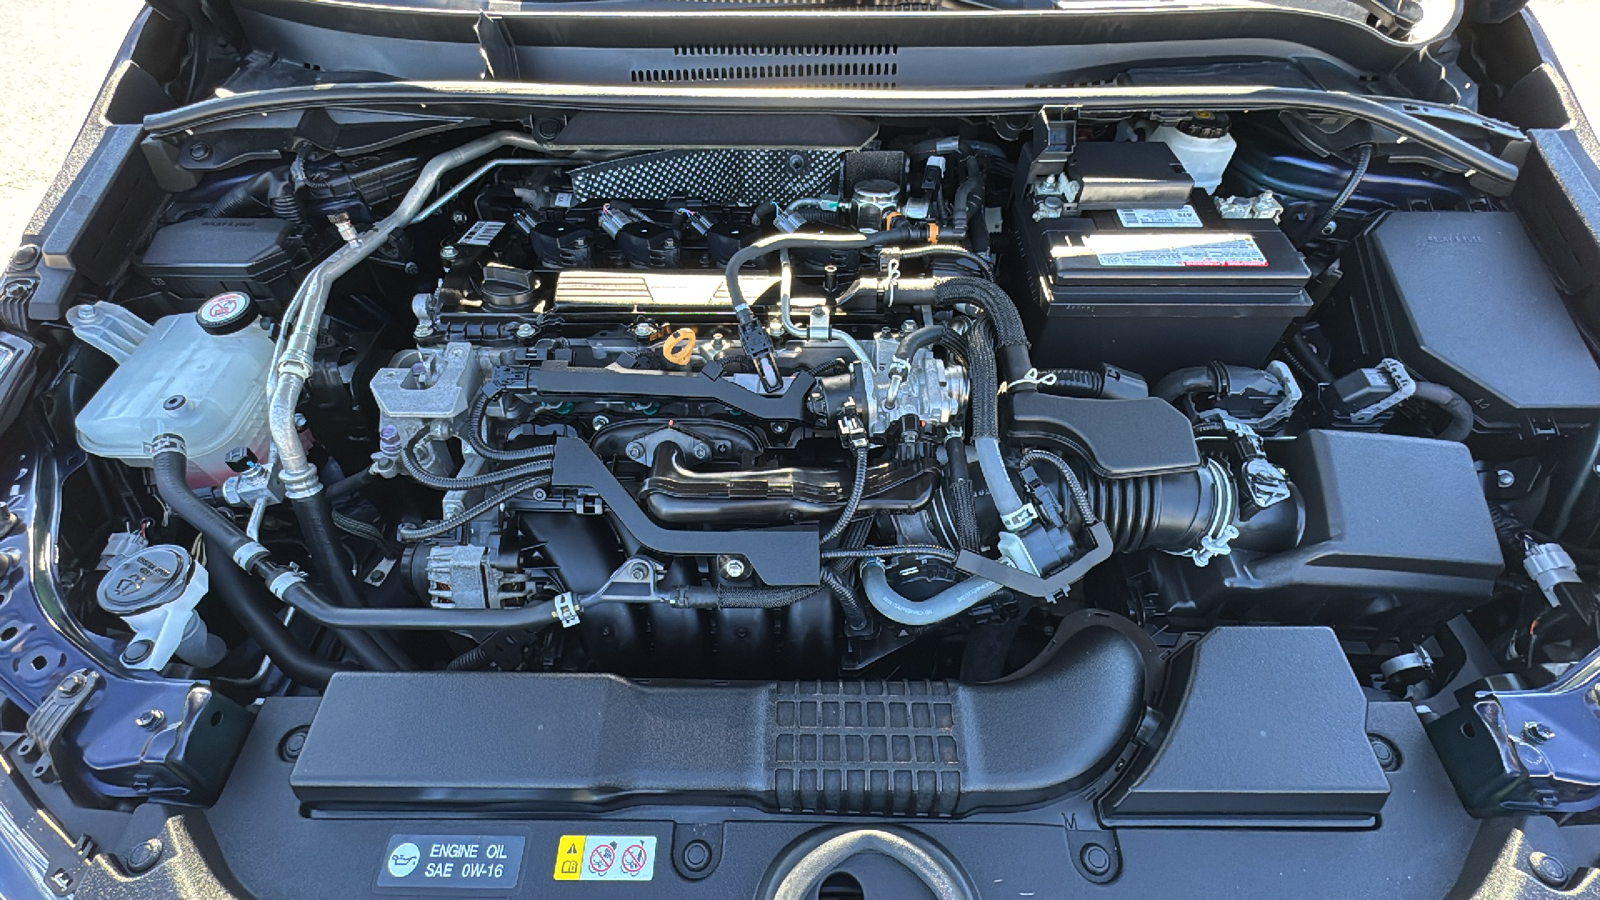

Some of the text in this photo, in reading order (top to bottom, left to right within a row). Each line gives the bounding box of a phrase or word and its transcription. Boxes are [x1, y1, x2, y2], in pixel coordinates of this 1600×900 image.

[1061, 812, 1078, 831] M
[430, 844, 507, 859] ENGINE OIL
[424, 863, 504, 878] SAE 0W-16
